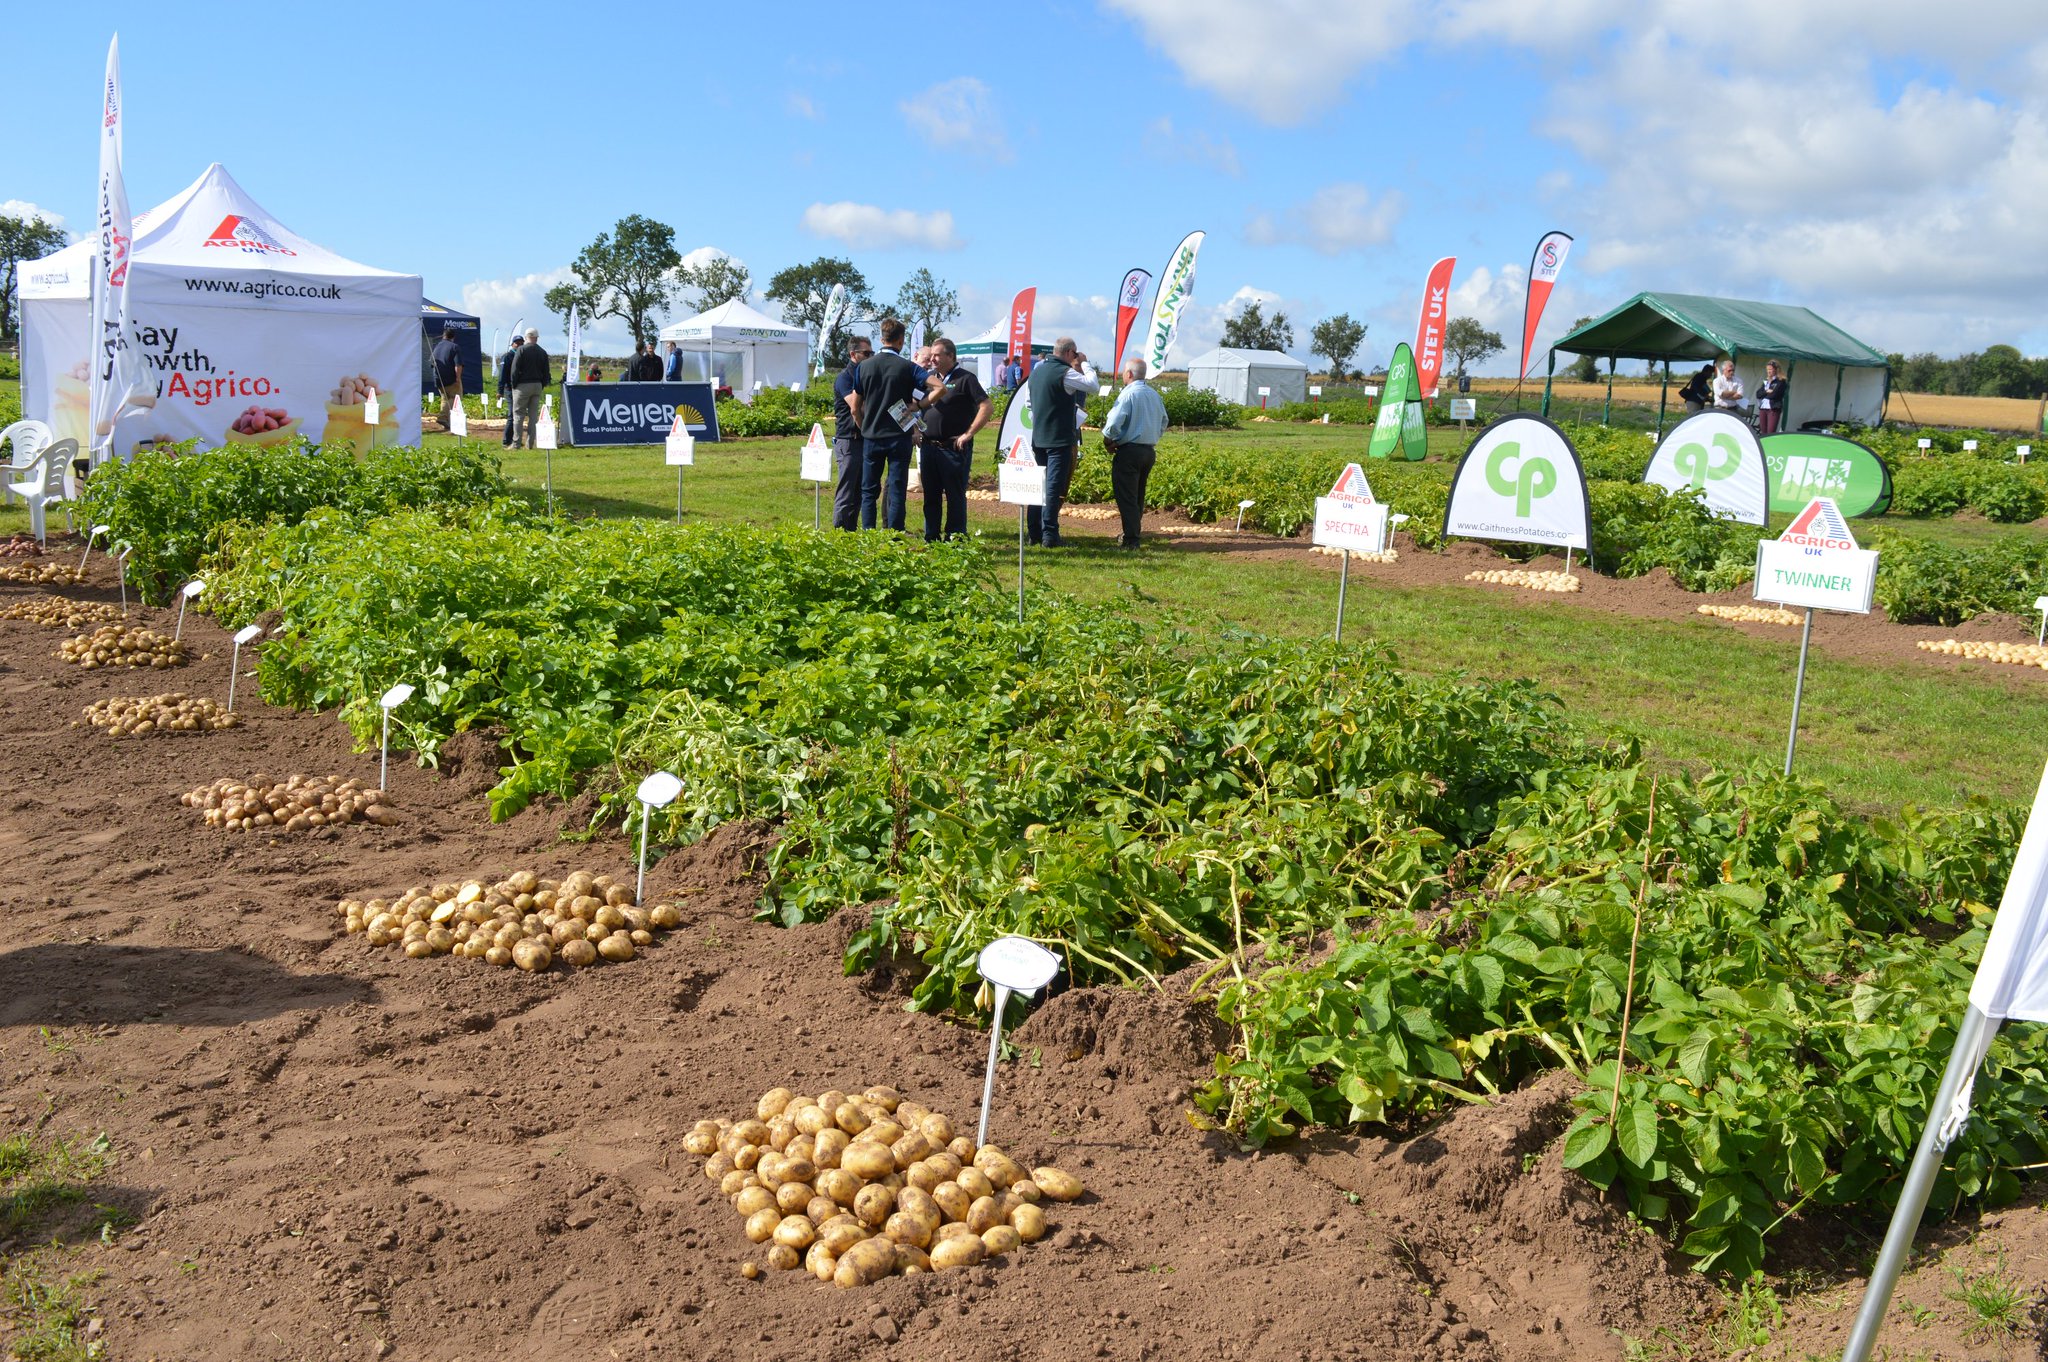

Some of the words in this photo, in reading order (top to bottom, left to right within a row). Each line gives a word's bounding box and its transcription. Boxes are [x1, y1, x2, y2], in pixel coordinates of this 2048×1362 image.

[202, 240, 298, 257] AGRICO
[241, 247, 268, 256] UK
[184, 278, 342, 300] www.agrico.co.uk
[1429, 286, 1445, 318] UK
[1015, 310, 1027, 335] UK
[739, 328, 788, 338] BRANSTON
[1421, 325, 1439, 371] STET
[1391, 362, 1406, 381] GPS
[168, 371, 280, 405] Agrico.
[1006, 459, 1035, 468] AGRICO
[1766, 455, 1784, 472] PS
[1329, 492, 1371, 505] AGRICO
[1342, 502, 1354, 510] UK
[1324, 520, 1370, 537] SPECTRA
[1457, 522, 1575, 540] www.CaithnessPotatoes.co
[1780, 534, 1852, 550] AGRICO
[1804, 547, 1823, 557] UK
[1774, 569, 1852, 592] TWINNER
